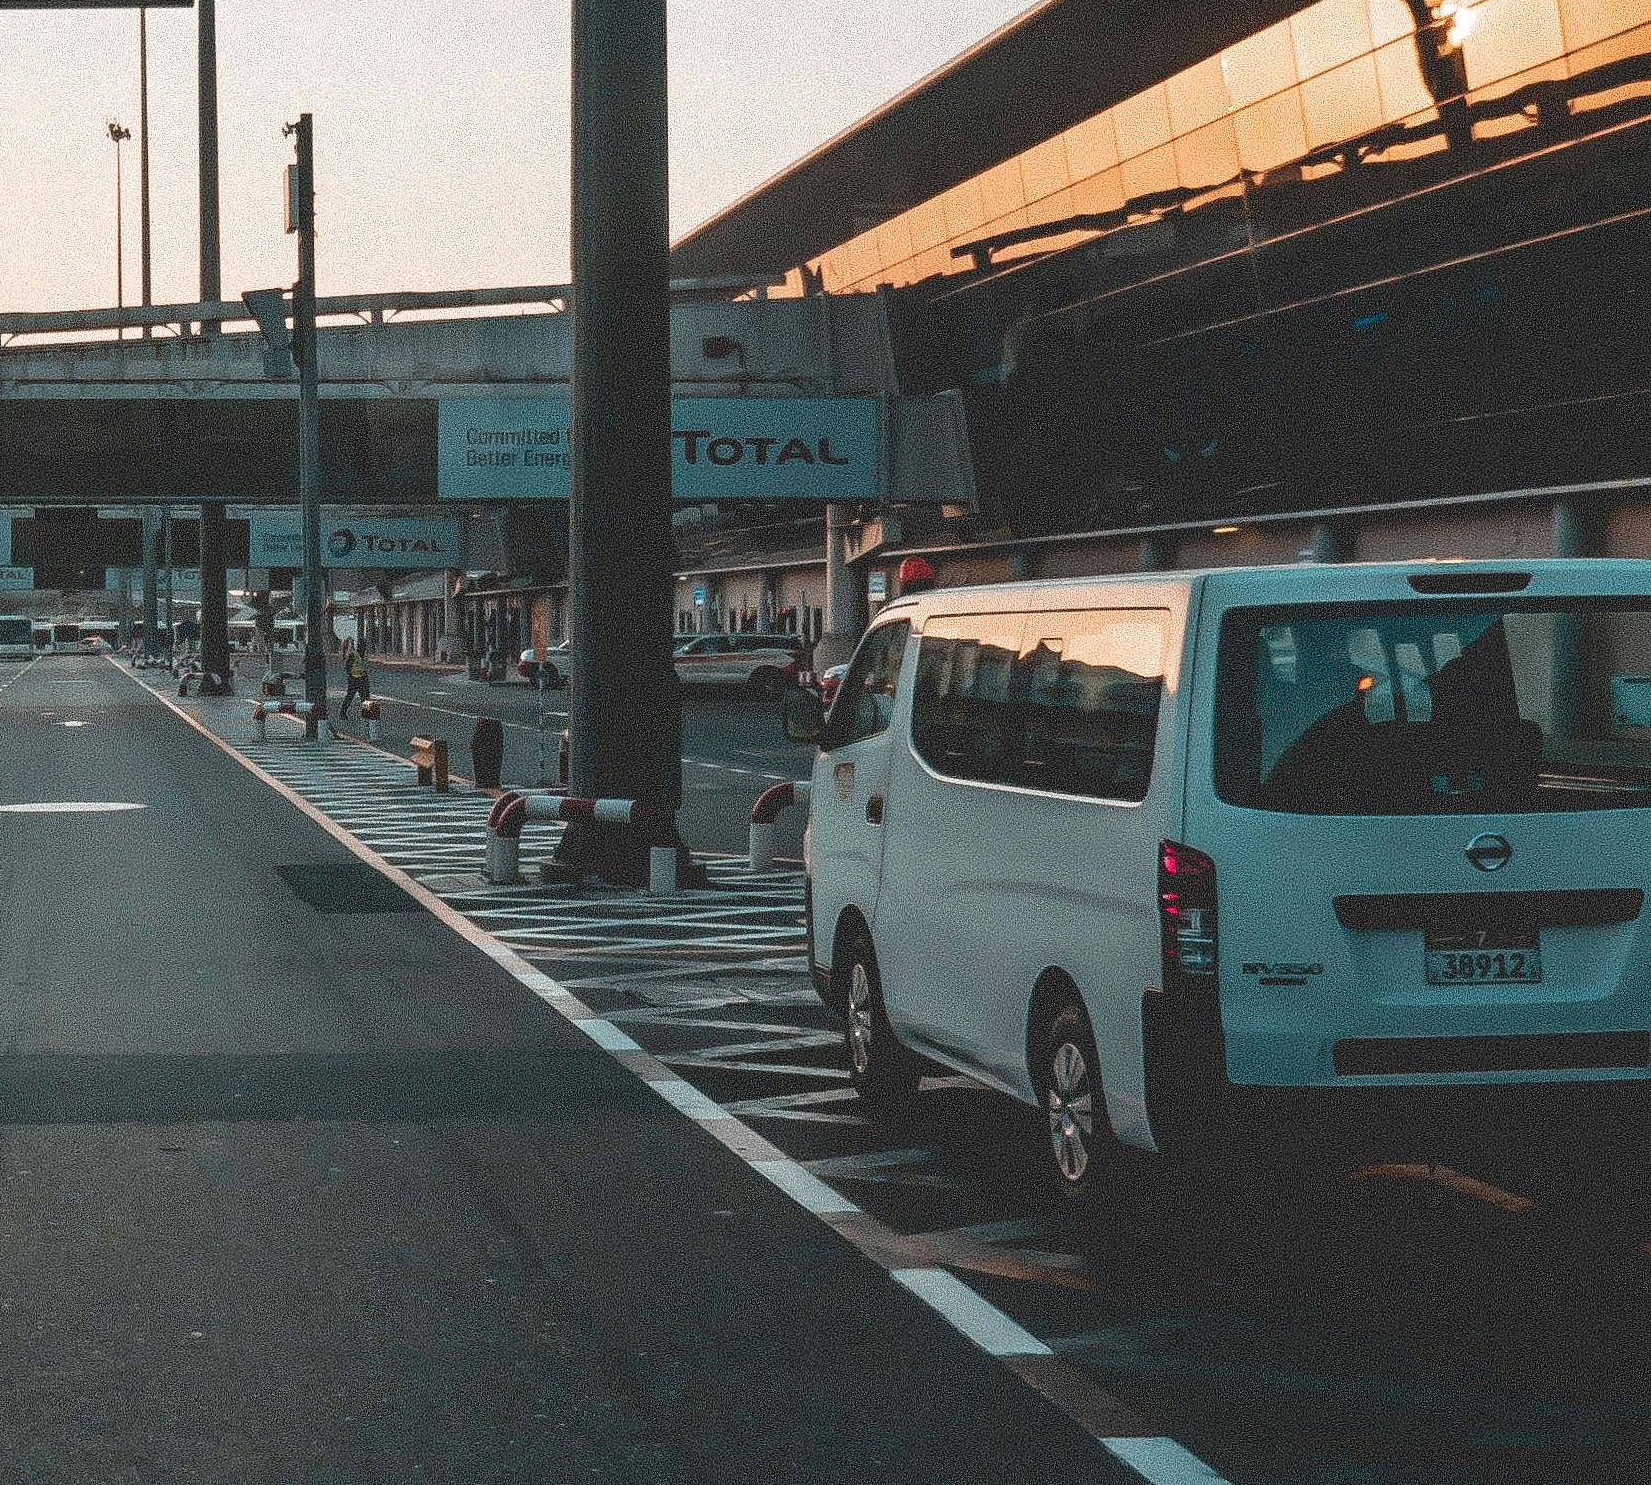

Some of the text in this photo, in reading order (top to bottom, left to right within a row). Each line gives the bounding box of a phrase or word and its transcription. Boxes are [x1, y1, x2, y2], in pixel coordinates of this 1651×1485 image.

[466, 428, 560, 445] Committed
[673, 430, 849, 466] TOTAL
[467, 450, 519, 467] Better
[362, 535, 446, 553] TOTAL
[1476, 930, 1487, 947] 7
[1442, 953, 1526, 979] 38912
